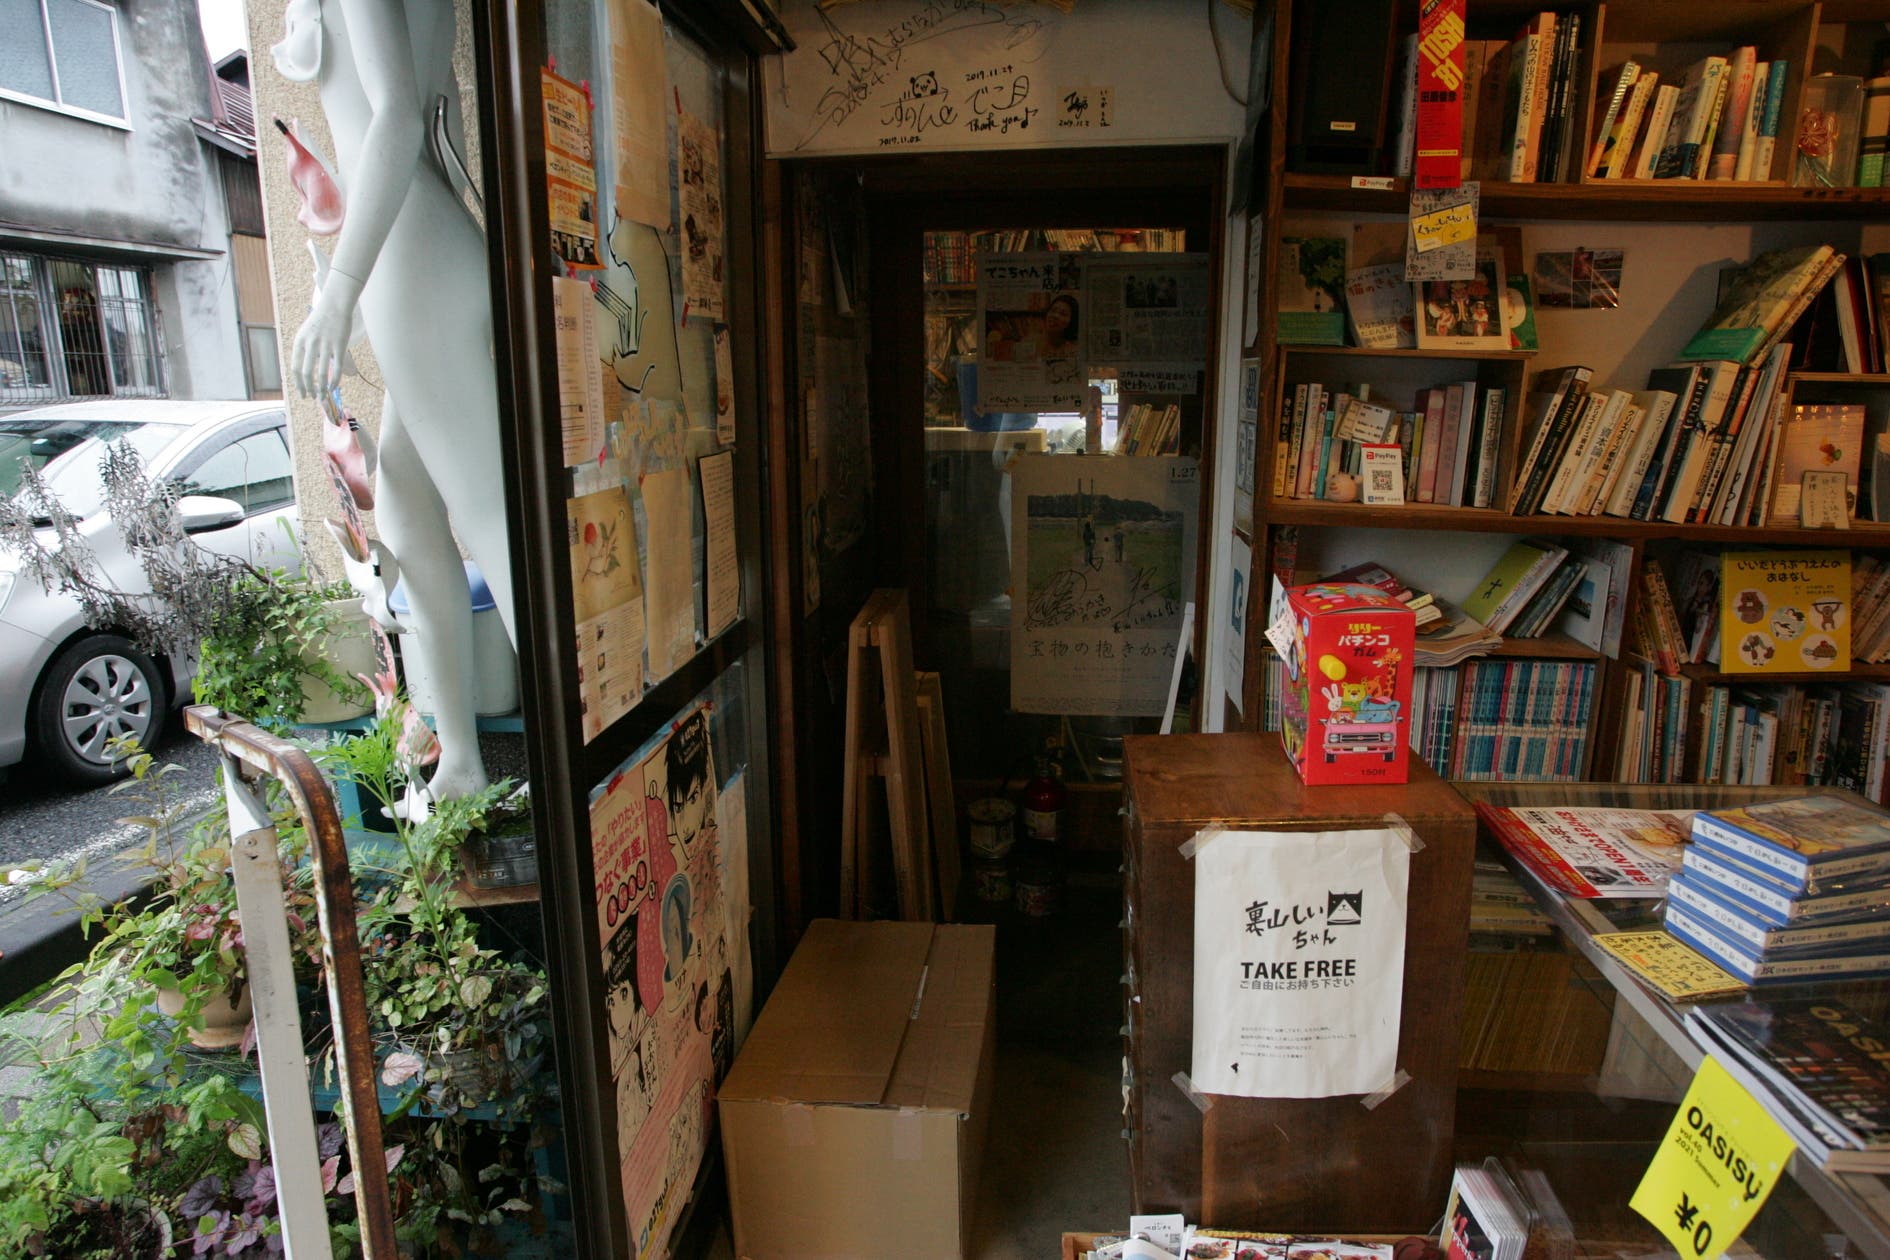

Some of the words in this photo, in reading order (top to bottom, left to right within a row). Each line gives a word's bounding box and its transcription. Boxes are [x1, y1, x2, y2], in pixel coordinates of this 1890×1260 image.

[964, 113, 999, 133] Thank
[1001, 116, 1023, 135] you
[1375, 452, 1397, 461] PayPay
[1767, 571, 1811, 583] おはなし
[1348, 623, 1382, 635] リリー
[1027, 639, 1176, 659] 宝物の抱きかた
[1338, 634, 1390, 647] パチンコ
[1353, 646, 1377, 657] ガム
[1245, 901, 1324, 937] 裏山しい
[1292, 929, 1337, 950] ちゃん
[1240, 961, 1298, 980] TAKE
[1303, 959, 1357, 978] FREE
[1239, 978, 1356, 991] ご自由にお持ち下さい
[1675, 1136, 1695, 1157] 2021
[1674, 1191, 1713, 1257] ¥0
